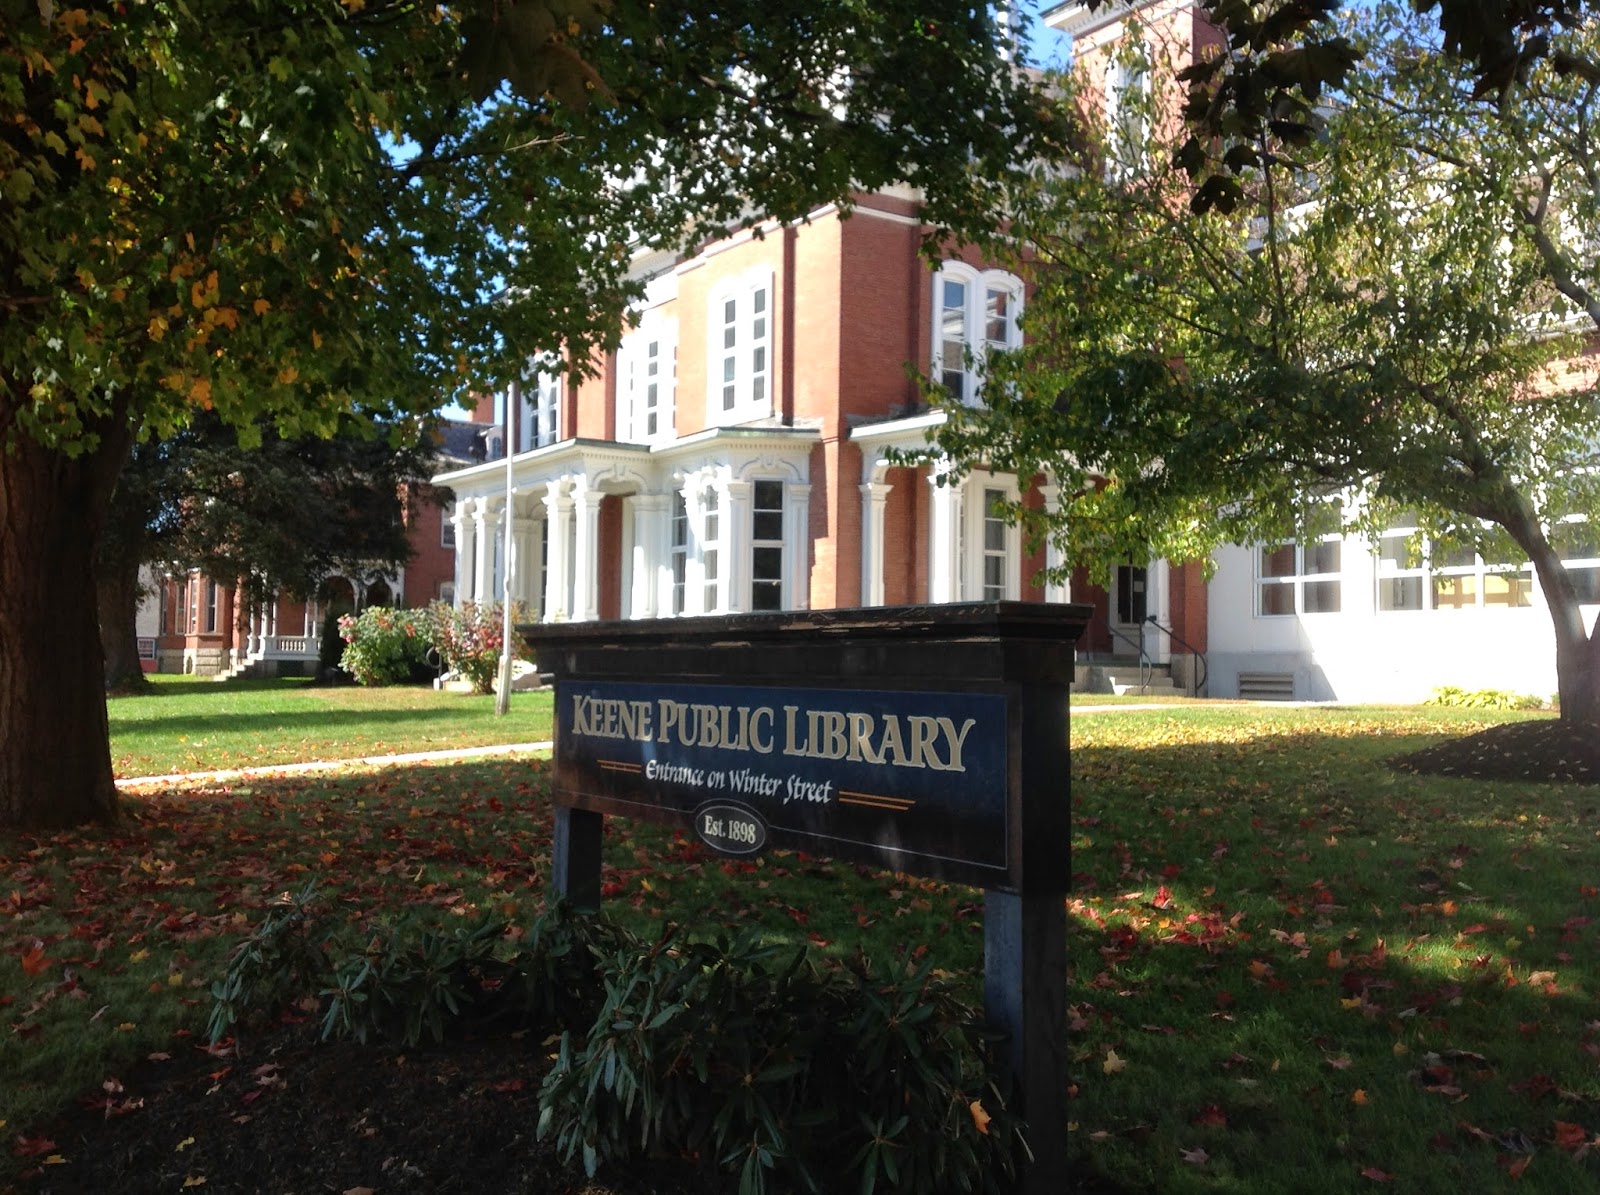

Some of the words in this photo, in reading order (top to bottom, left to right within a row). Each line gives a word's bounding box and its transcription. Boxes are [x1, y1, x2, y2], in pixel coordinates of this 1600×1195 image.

[572, 695, 653, 741] KEENE
[657, 699, 774, 753] PUBLIC
[783, 706, 976, 772] LIBRARY
[645, 760, 704, 786] Entrance
[707, 771, 725, 789] on
[729, 768, 782, 797] Winter
[783, 774, 833, 805] Street
[704, 815, 726, 838] Est.
[728, 820, 756, 844] 1898
